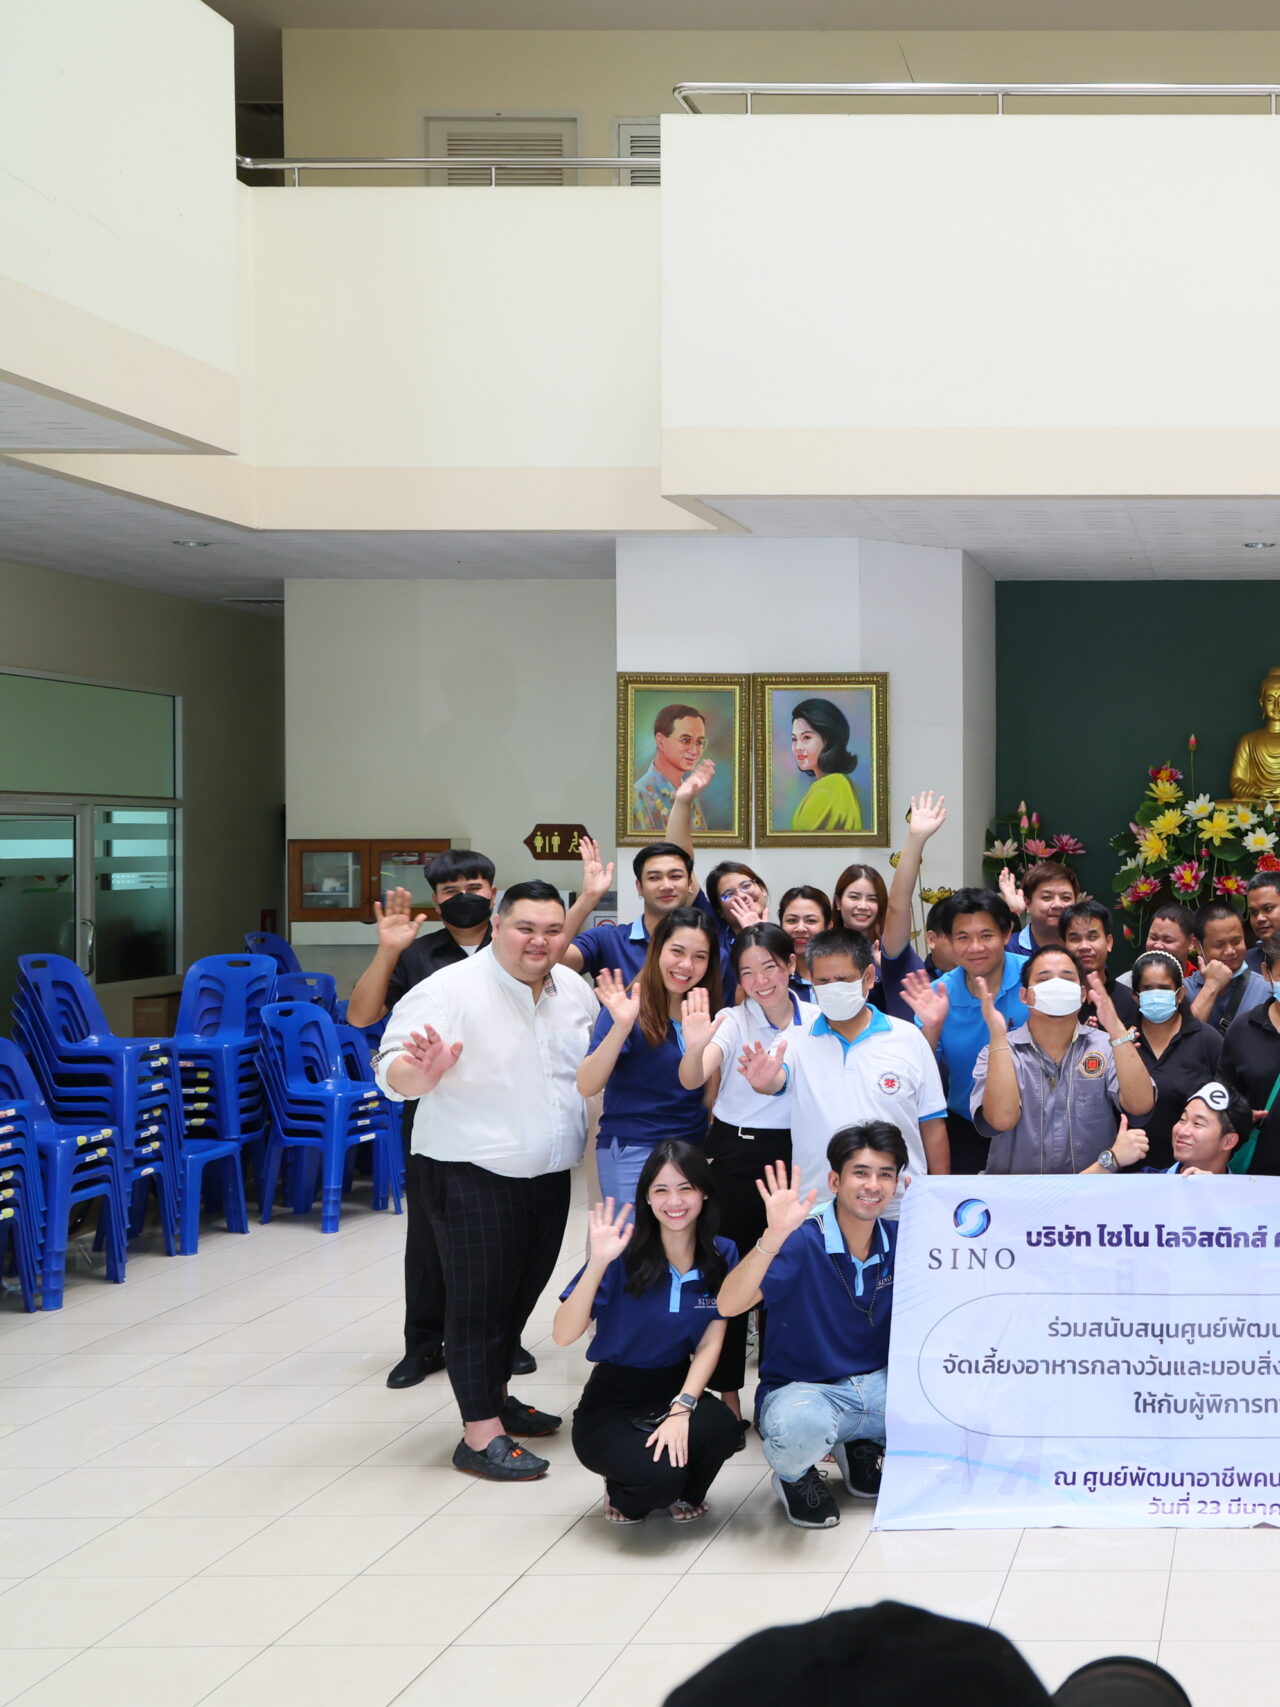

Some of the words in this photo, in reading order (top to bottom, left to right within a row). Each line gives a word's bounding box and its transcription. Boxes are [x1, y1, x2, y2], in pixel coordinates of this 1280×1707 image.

[1209, 1089, 1227, 1105] e
[1025, 1224, 1091, 1248] บริษัท
[1097, 1223, 1149, 1248] ไซโน
[1155, 1223, 1268, 1249] โลจิสติกส์
[928, 1247, 1016, 1270] SINO
[1054, 1470, 1076, 1487] ณ
[1148, 1492, 1190, 1515] วันที่
[1197, 1500, 1221, 1515] 23
